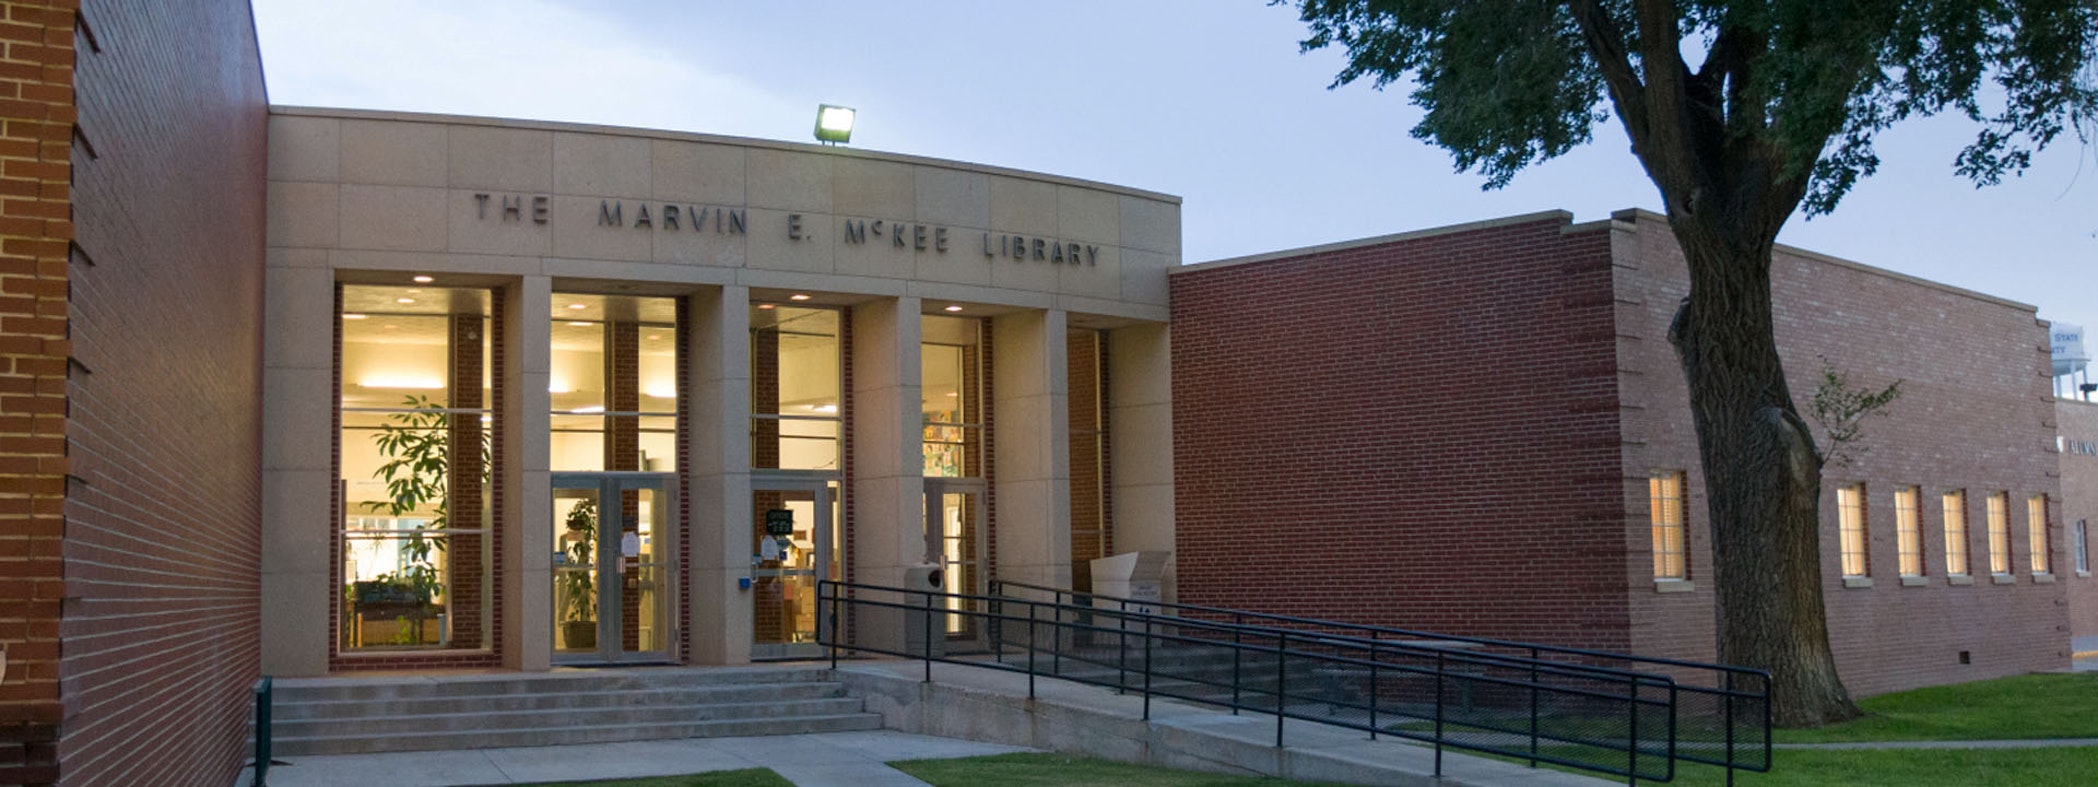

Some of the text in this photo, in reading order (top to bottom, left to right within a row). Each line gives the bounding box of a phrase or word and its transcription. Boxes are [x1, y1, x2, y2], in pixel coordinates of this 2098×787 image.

[474, 193, 549, 225] THE
[599, 200, 747, 234] MARVIN
[788, 213, 812, 241] E.
[983, 232, 1100, 268] LIBRARY
